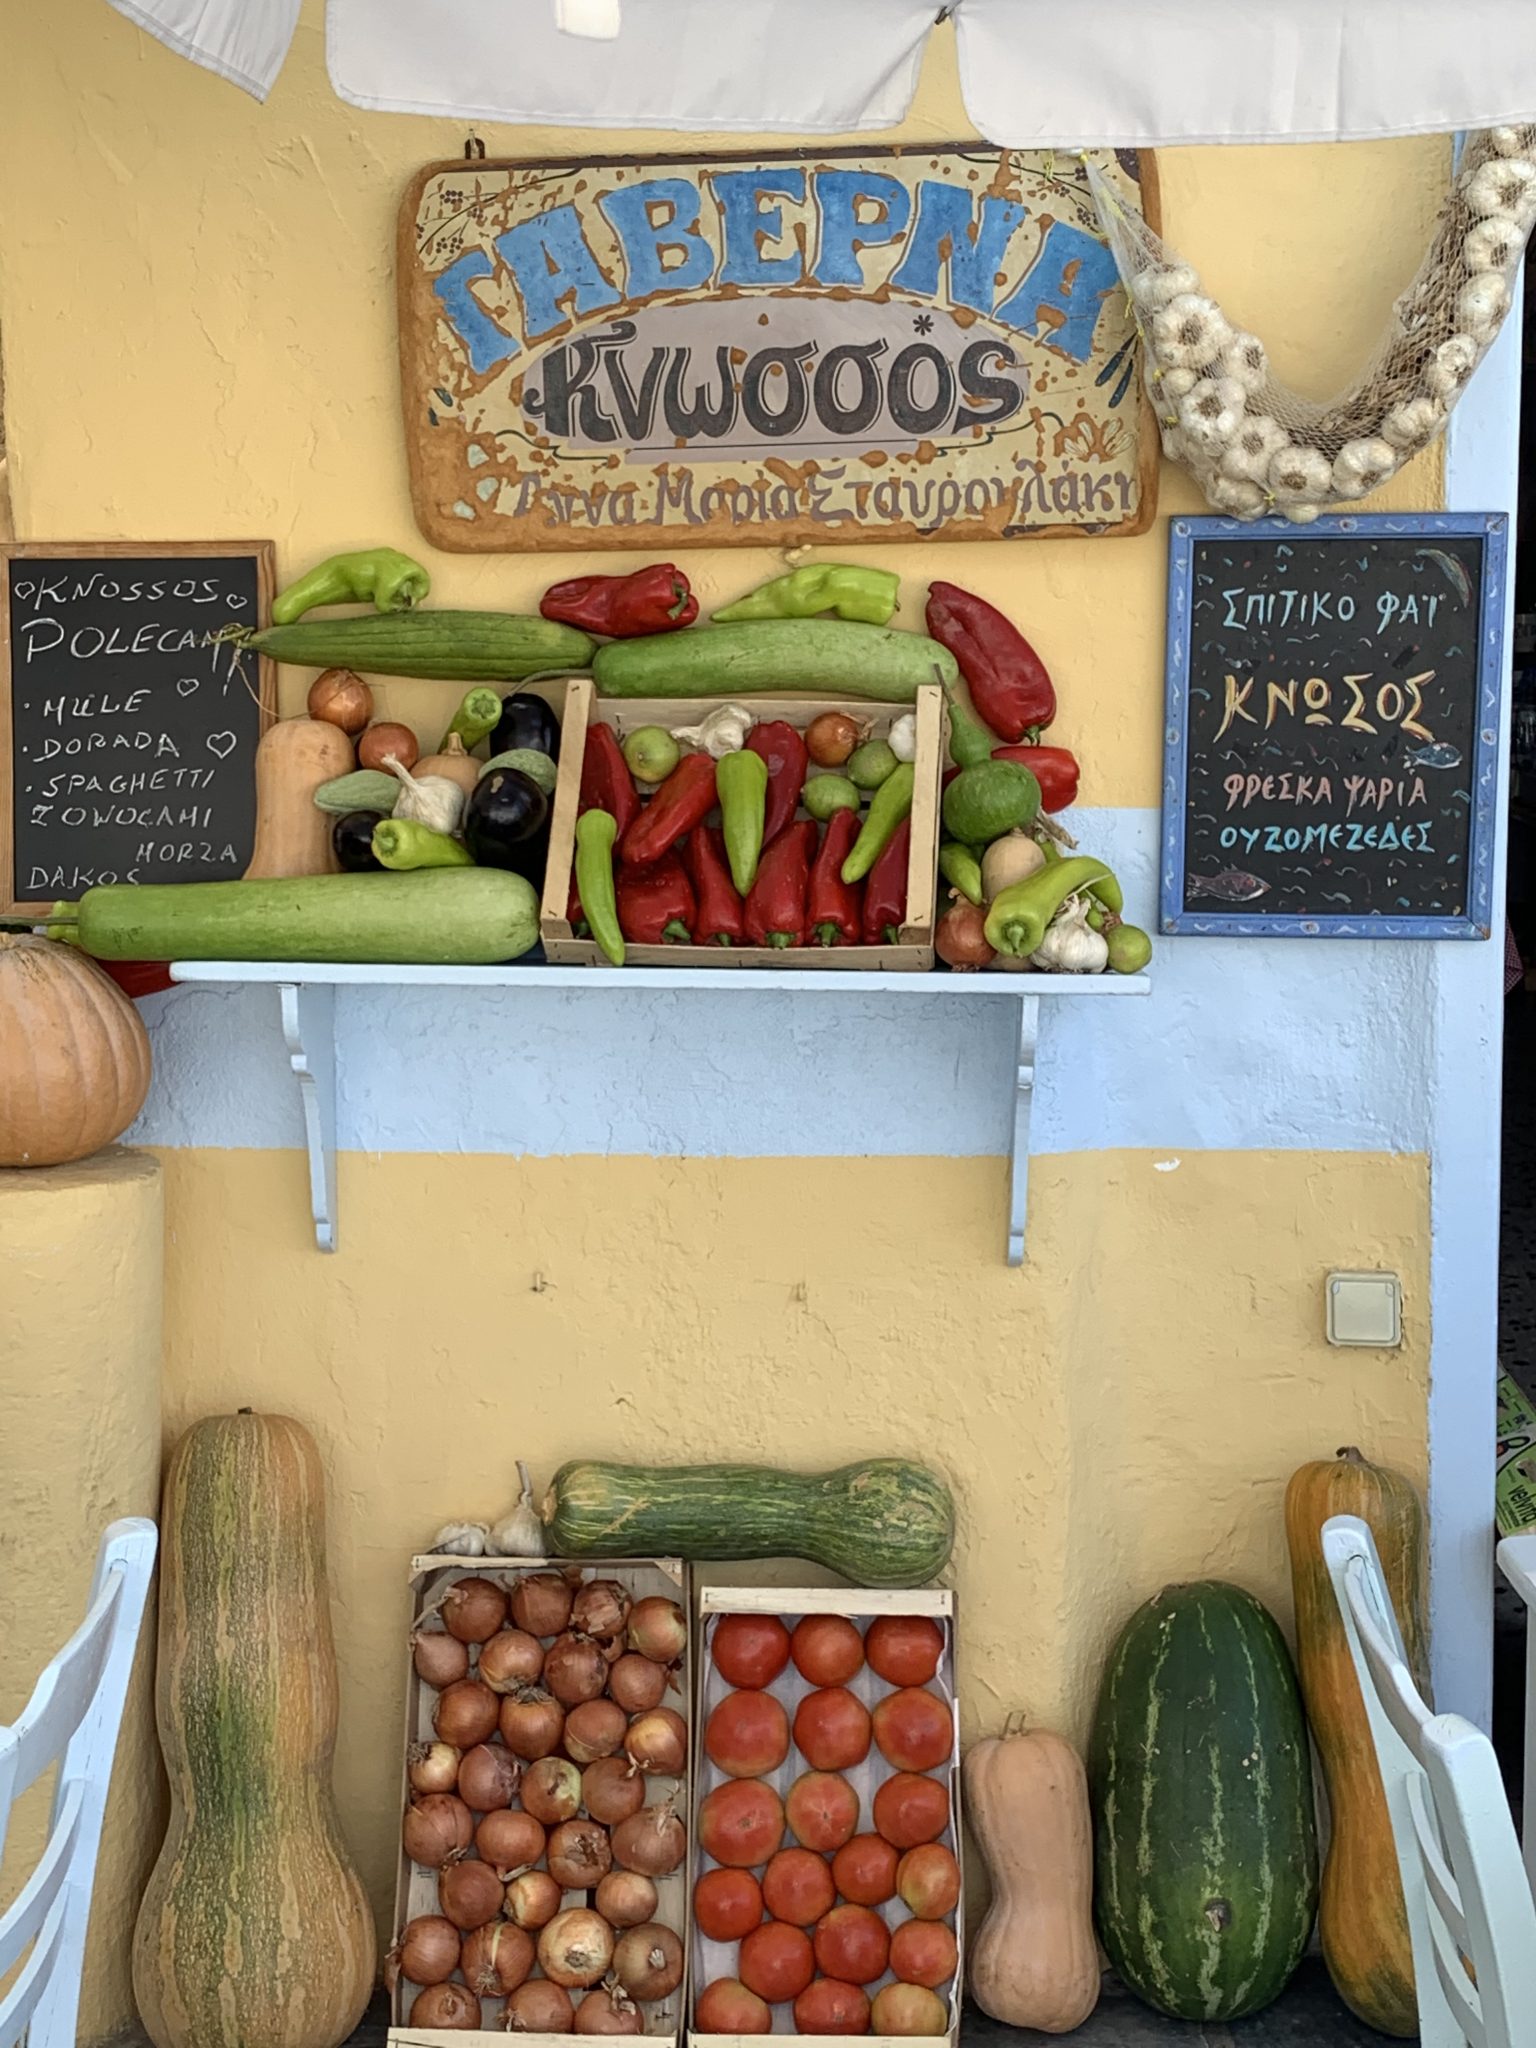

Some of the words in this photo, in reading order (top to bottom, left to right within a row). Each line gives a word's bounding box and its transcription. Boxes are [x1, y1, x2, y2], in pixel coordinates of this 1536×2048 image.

[34, 573, 220, 611] KNOSSOS
[1222, 587, 1356, 631] ΣΠΙΤΙΚΟ
[1213, 669, 1437, 743] ΚΝΩΣΟΣ
[33, 731, 181, 763] DORADA
[42, 768, 215, 797] SPAGHETTI
[1223, 772, 1333, 813] ΦΡΕΣΚΑ
[1343, 774, 1428, 819] ΨΑΡΙΑ
[61, 804, 213, 829] OWOCAMI
[135, 841, 239, 864] MORZA
[1219, 820, 1436, 855] ΟΥΖΟΜΕΖΕΔΕΣ
